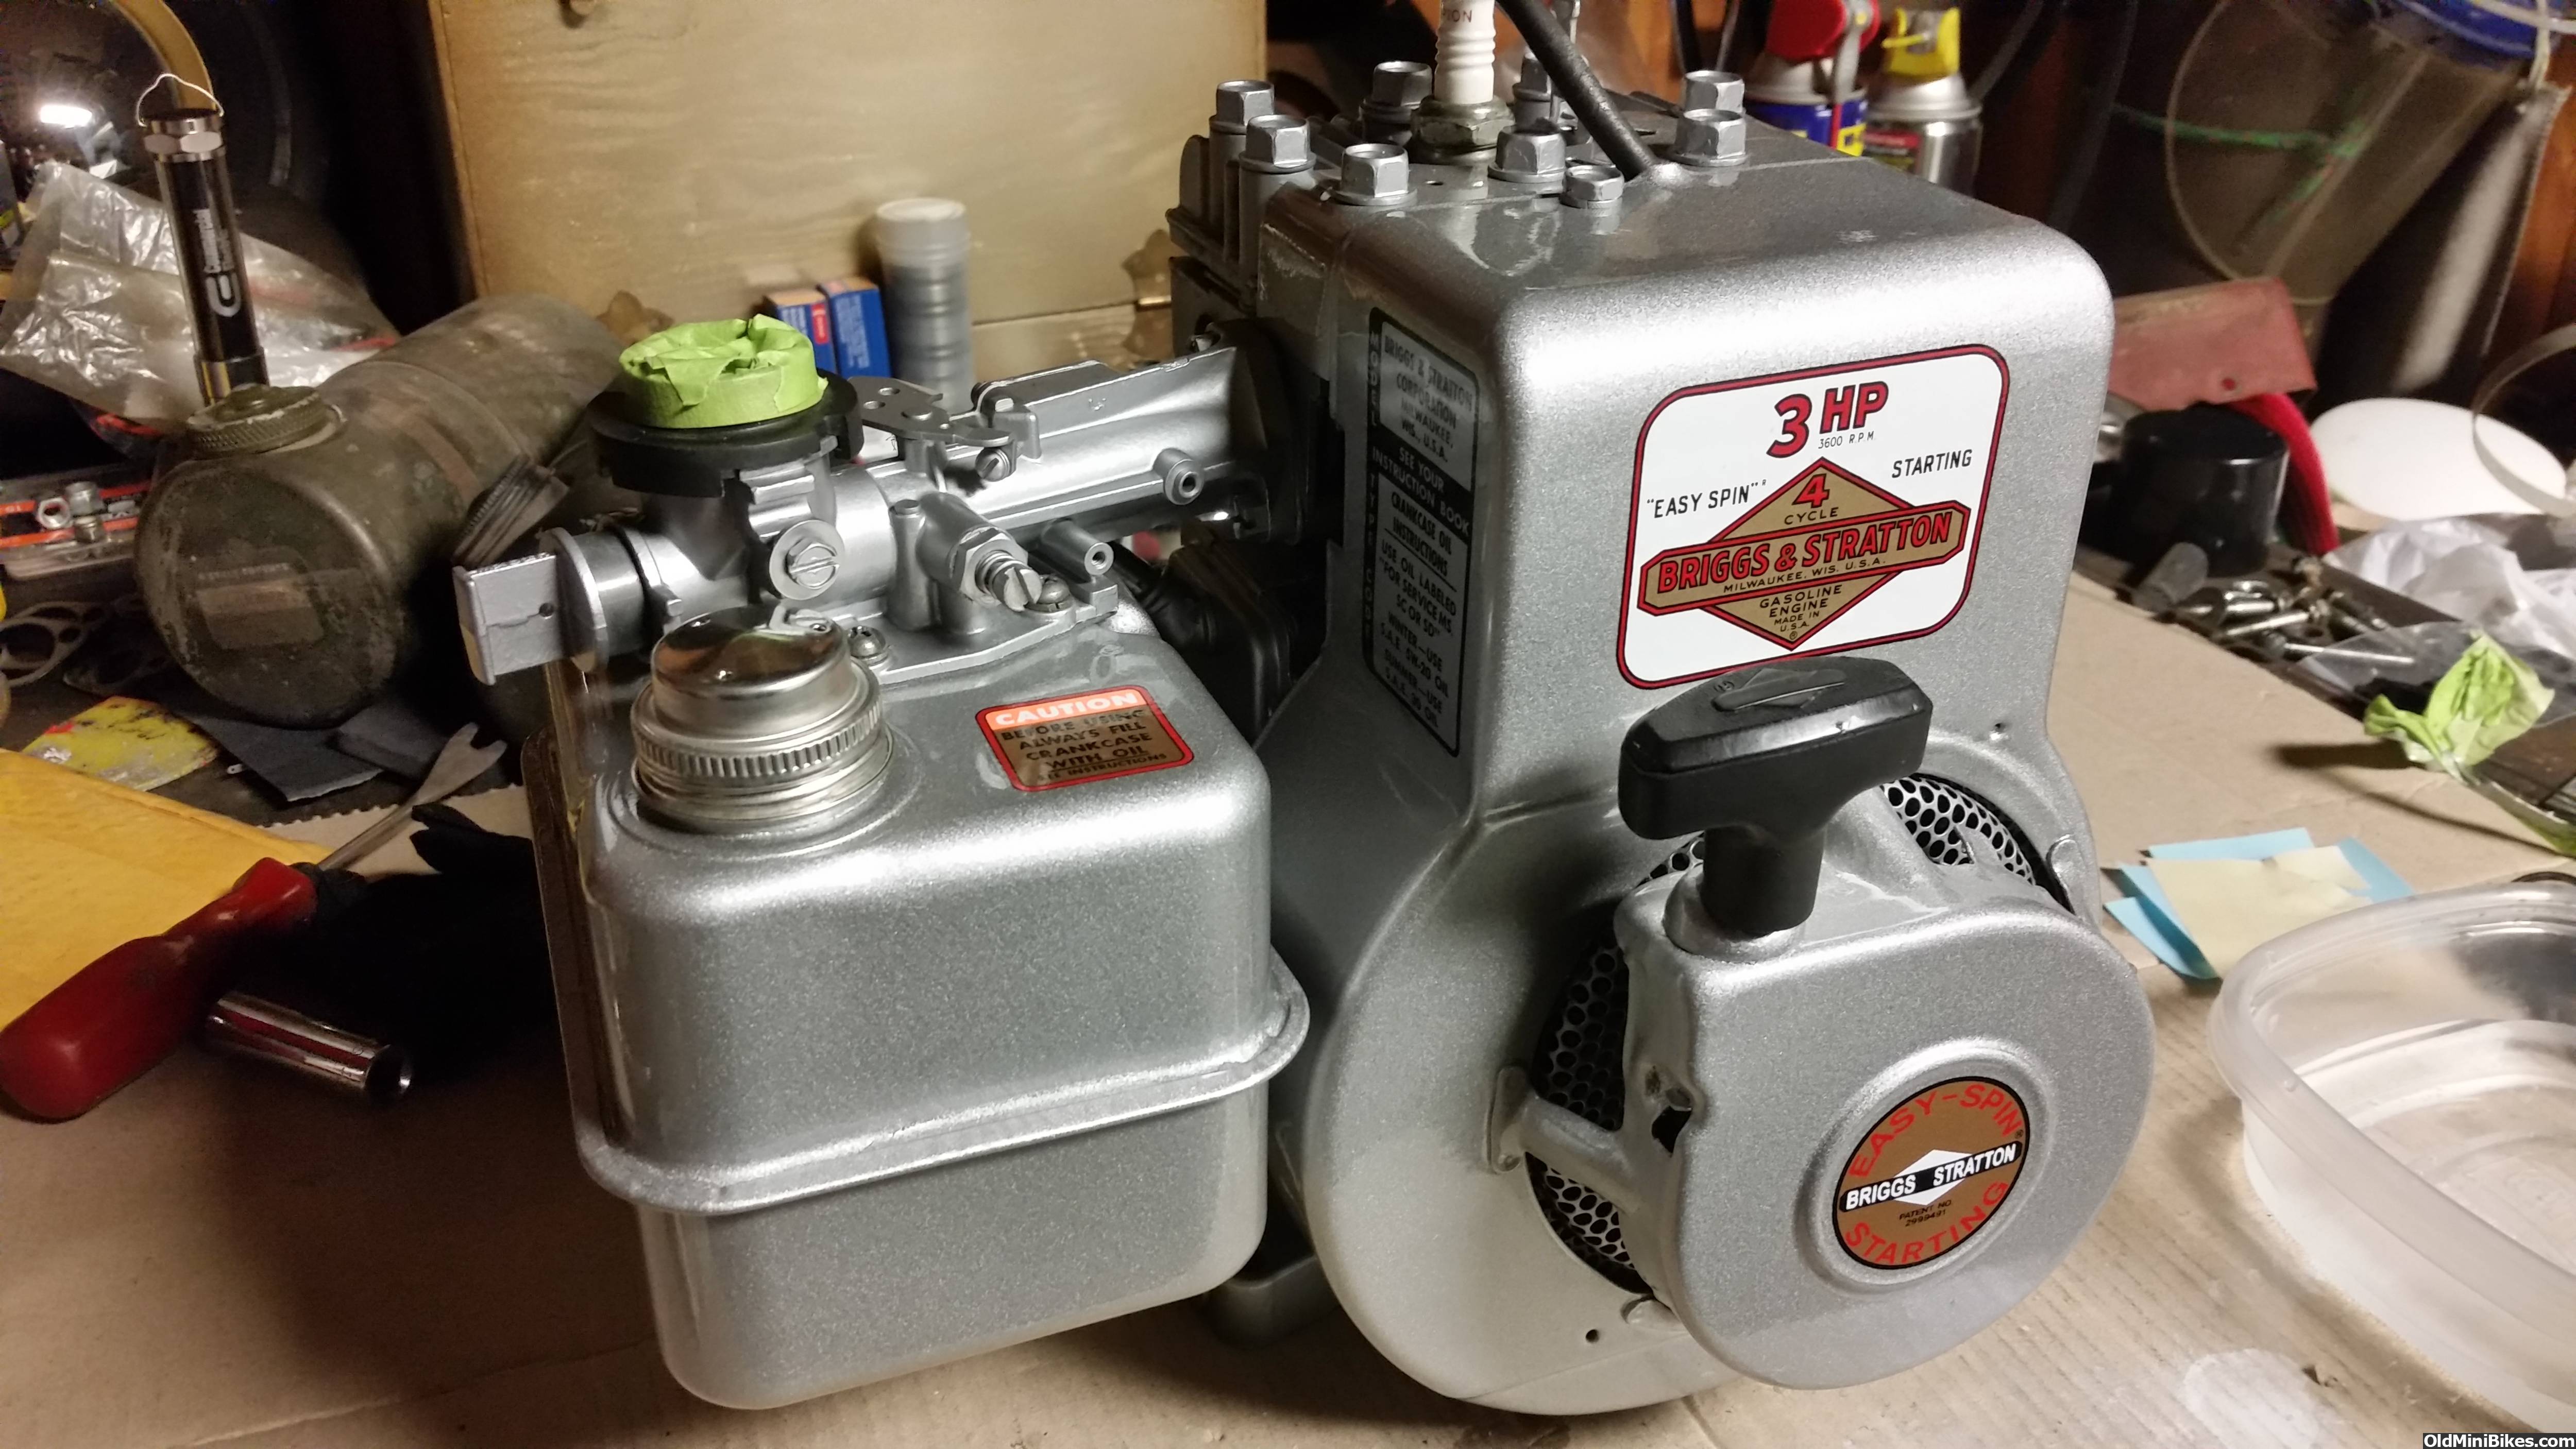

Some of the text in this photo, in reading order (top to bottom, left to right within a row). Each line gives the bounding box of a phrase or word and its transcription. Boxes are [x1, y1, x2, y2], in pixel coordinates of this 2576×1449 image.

[1385, 335, 1414, 370] BRIGGS
[1428, 366, 1472, 412] STRATTON
[1396, 372, 1456, 429] CORPORATION
[1767, 381, 1889, 458] 3 HP
[1818, 436, 1843, 449] 3600
[1399, 447, 1444, 491] SEE YOUR
[1892, 449, 1973, 479] STARTING
[1372, 446, 1469, 537] INSTRUCTION BOOK
[1792, 473, 1830, 508] 4
[1392, 492, 1452, 555] CRANKCASE OIL
[1784, 507, 1838, 524] CYCLE
[1393, 516, 1448, 577] INSTRUCTIONS
[1657, 511, 1954, 594] BRIGGS & STRATTON
[1381, 539, 1456, 617] USE OIL LABELED
[1812, 566, 1838, 576] WIS.
[1845, 558, 1886, 570] U.S.A.
[1396, 594, 1407, 614] SC
[1409, 605, 1421, 627] OR
[1402, 579, 1437, 618] SERVICE
[1759, 584, 1842, 608] GASOLINE
[1769, 598, 1828, 618] ENGINE
[1774, 614, 1803, 625] MADE
[1780, 621, 1809, 632] U.S.A.
[1435, 675, 1449, 698] OIL
[995, 693, 1138, 726] CAUTION
[1425, 706, 1438, 728] OIL
[1001, 710, 1144, 741] BEFORE USING
[1019, 722, 1146, 750] ALWAYS FILL
[1026, 733, 1153, 760] CRANKCASE
[1046, 745, 1149, 770] WITH OIL
[1067, 754, 1167, 775] INSTRUCTIONS
[1849, 1083, 2023, 1178] EASY-SPIN
[1845, 1143, 2016, 1211] BRIGGS STRATTON
[1845, 1181, 2008, 1265] STARTING
[1900, 1200, 1952, 1220] PATENT NO
[1905, 1209, 1945, 1227] 2999491
